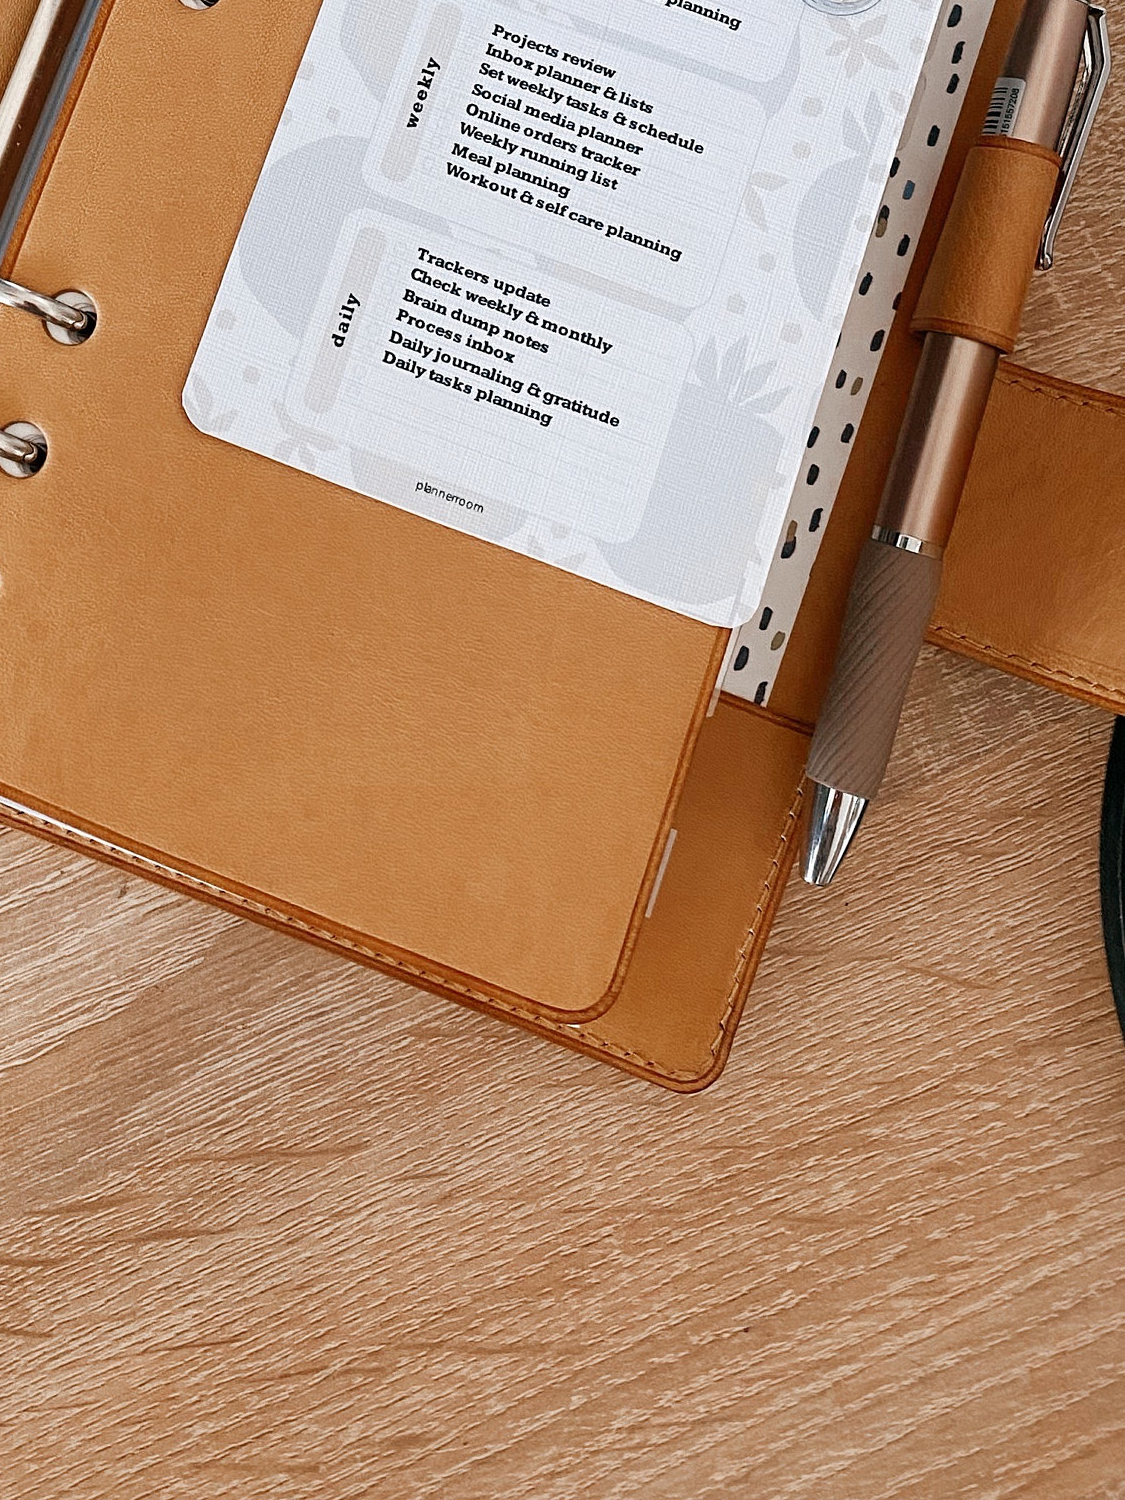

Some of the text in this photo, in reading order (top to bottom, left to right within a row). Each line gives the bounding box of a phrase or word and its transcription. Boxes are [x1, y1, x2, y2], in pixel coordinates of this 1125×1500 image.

[485, 43, 654, 114] Inbox planner & lists
[492, 24, 617, 79] Projects review
[407, 57, 441, 129] weekly
[471, 84, 644, 156] Social media planner
[479, 63, 705, 155] Set weekly tasks & schedule
[451, 143, 571, 199] Meal planning
[461, 122, 619, 191] Weekly running list
[466, 103, 642, 177] Online orders tracker
[447, 162, 683, 263] Workout & self care planning
[411, 268, 614, 355] Check weekly & monthly
[418, 247, 551, 308] Trackers update
[332, 293, 361, 348] daily
[396, 308, 516, 364] Process inbox
[402, 289, 550, 354] Brain dump notes
[382, 350, 554, 428] Daily tasks planning
[388, 330, 620, 427] Daily journaling & gratitude
[415, 482, 484, 514] plannerroom
